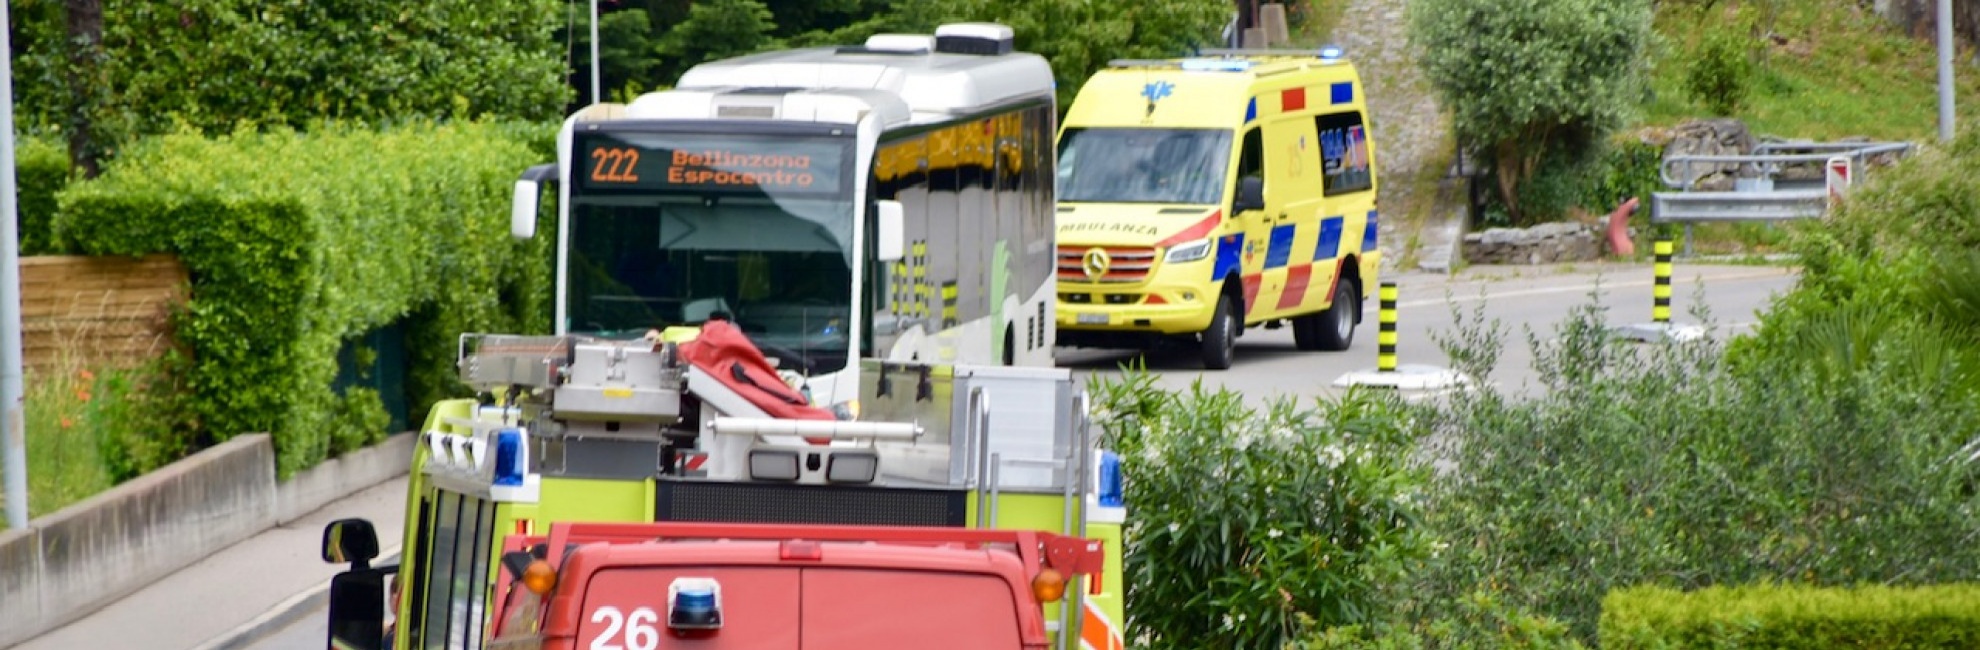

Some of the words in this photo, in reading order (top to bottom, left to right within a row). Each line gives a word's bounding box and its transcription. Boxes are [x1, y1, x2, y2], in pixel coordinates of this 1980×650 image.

[591, 146, 639, 182] 222
[672, 149, 811, 168] Bellinzona
[667, 165, 813, 186] Espocentro
[1055, 222, 1158, 236] MBULANZA
[590, 606, 660, 650] 26
